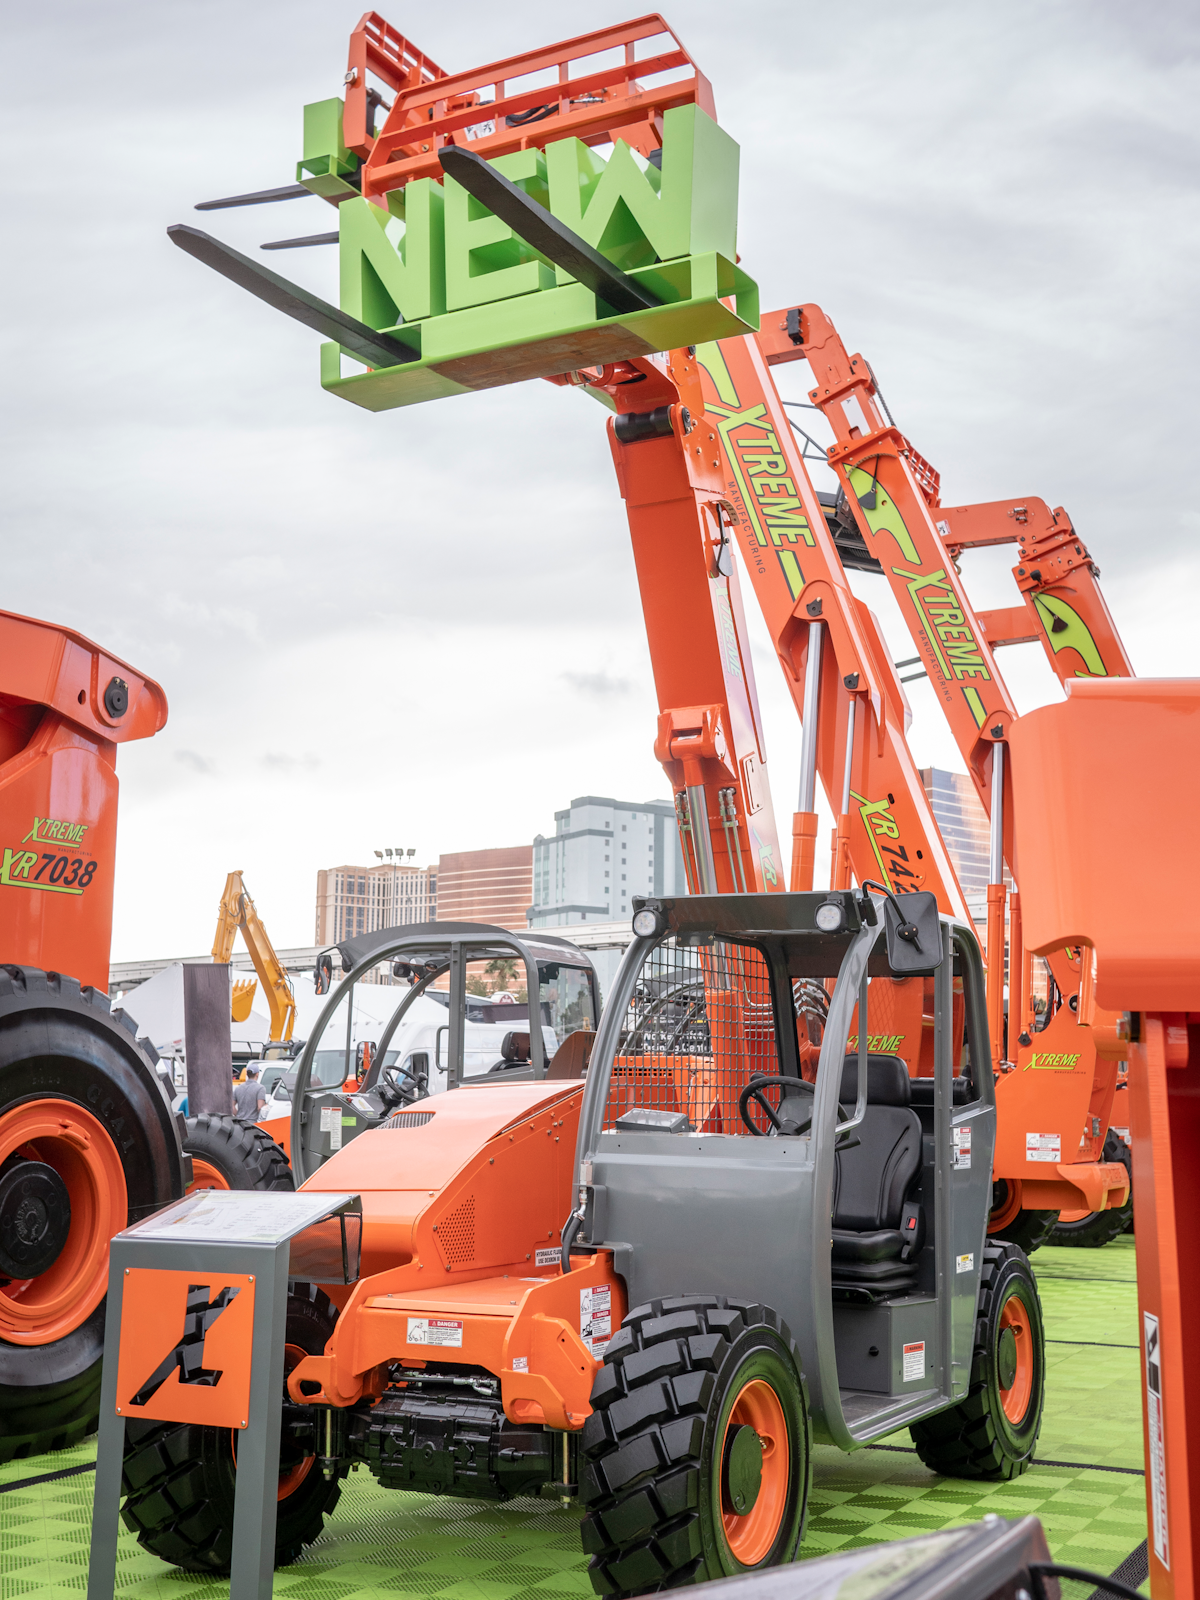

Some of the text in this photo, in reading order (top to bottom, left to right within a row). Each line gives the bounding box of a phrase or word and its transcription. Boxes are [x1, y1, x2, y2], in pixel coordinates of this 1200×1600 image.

[339, 103, 696, 331] NEW
[703, 402, 817, 548] XTREME
[727, 481, 766, 575] MANUFACTURING
[710, 570, 742, 682] XTREME
[891, 566, 992, 681] XTREME
[918, 629, 953, 702] MANUFACTURING
[21, 816, 89, 848] XTREME
[1022, 1053, 1082, 1072] XTREME
